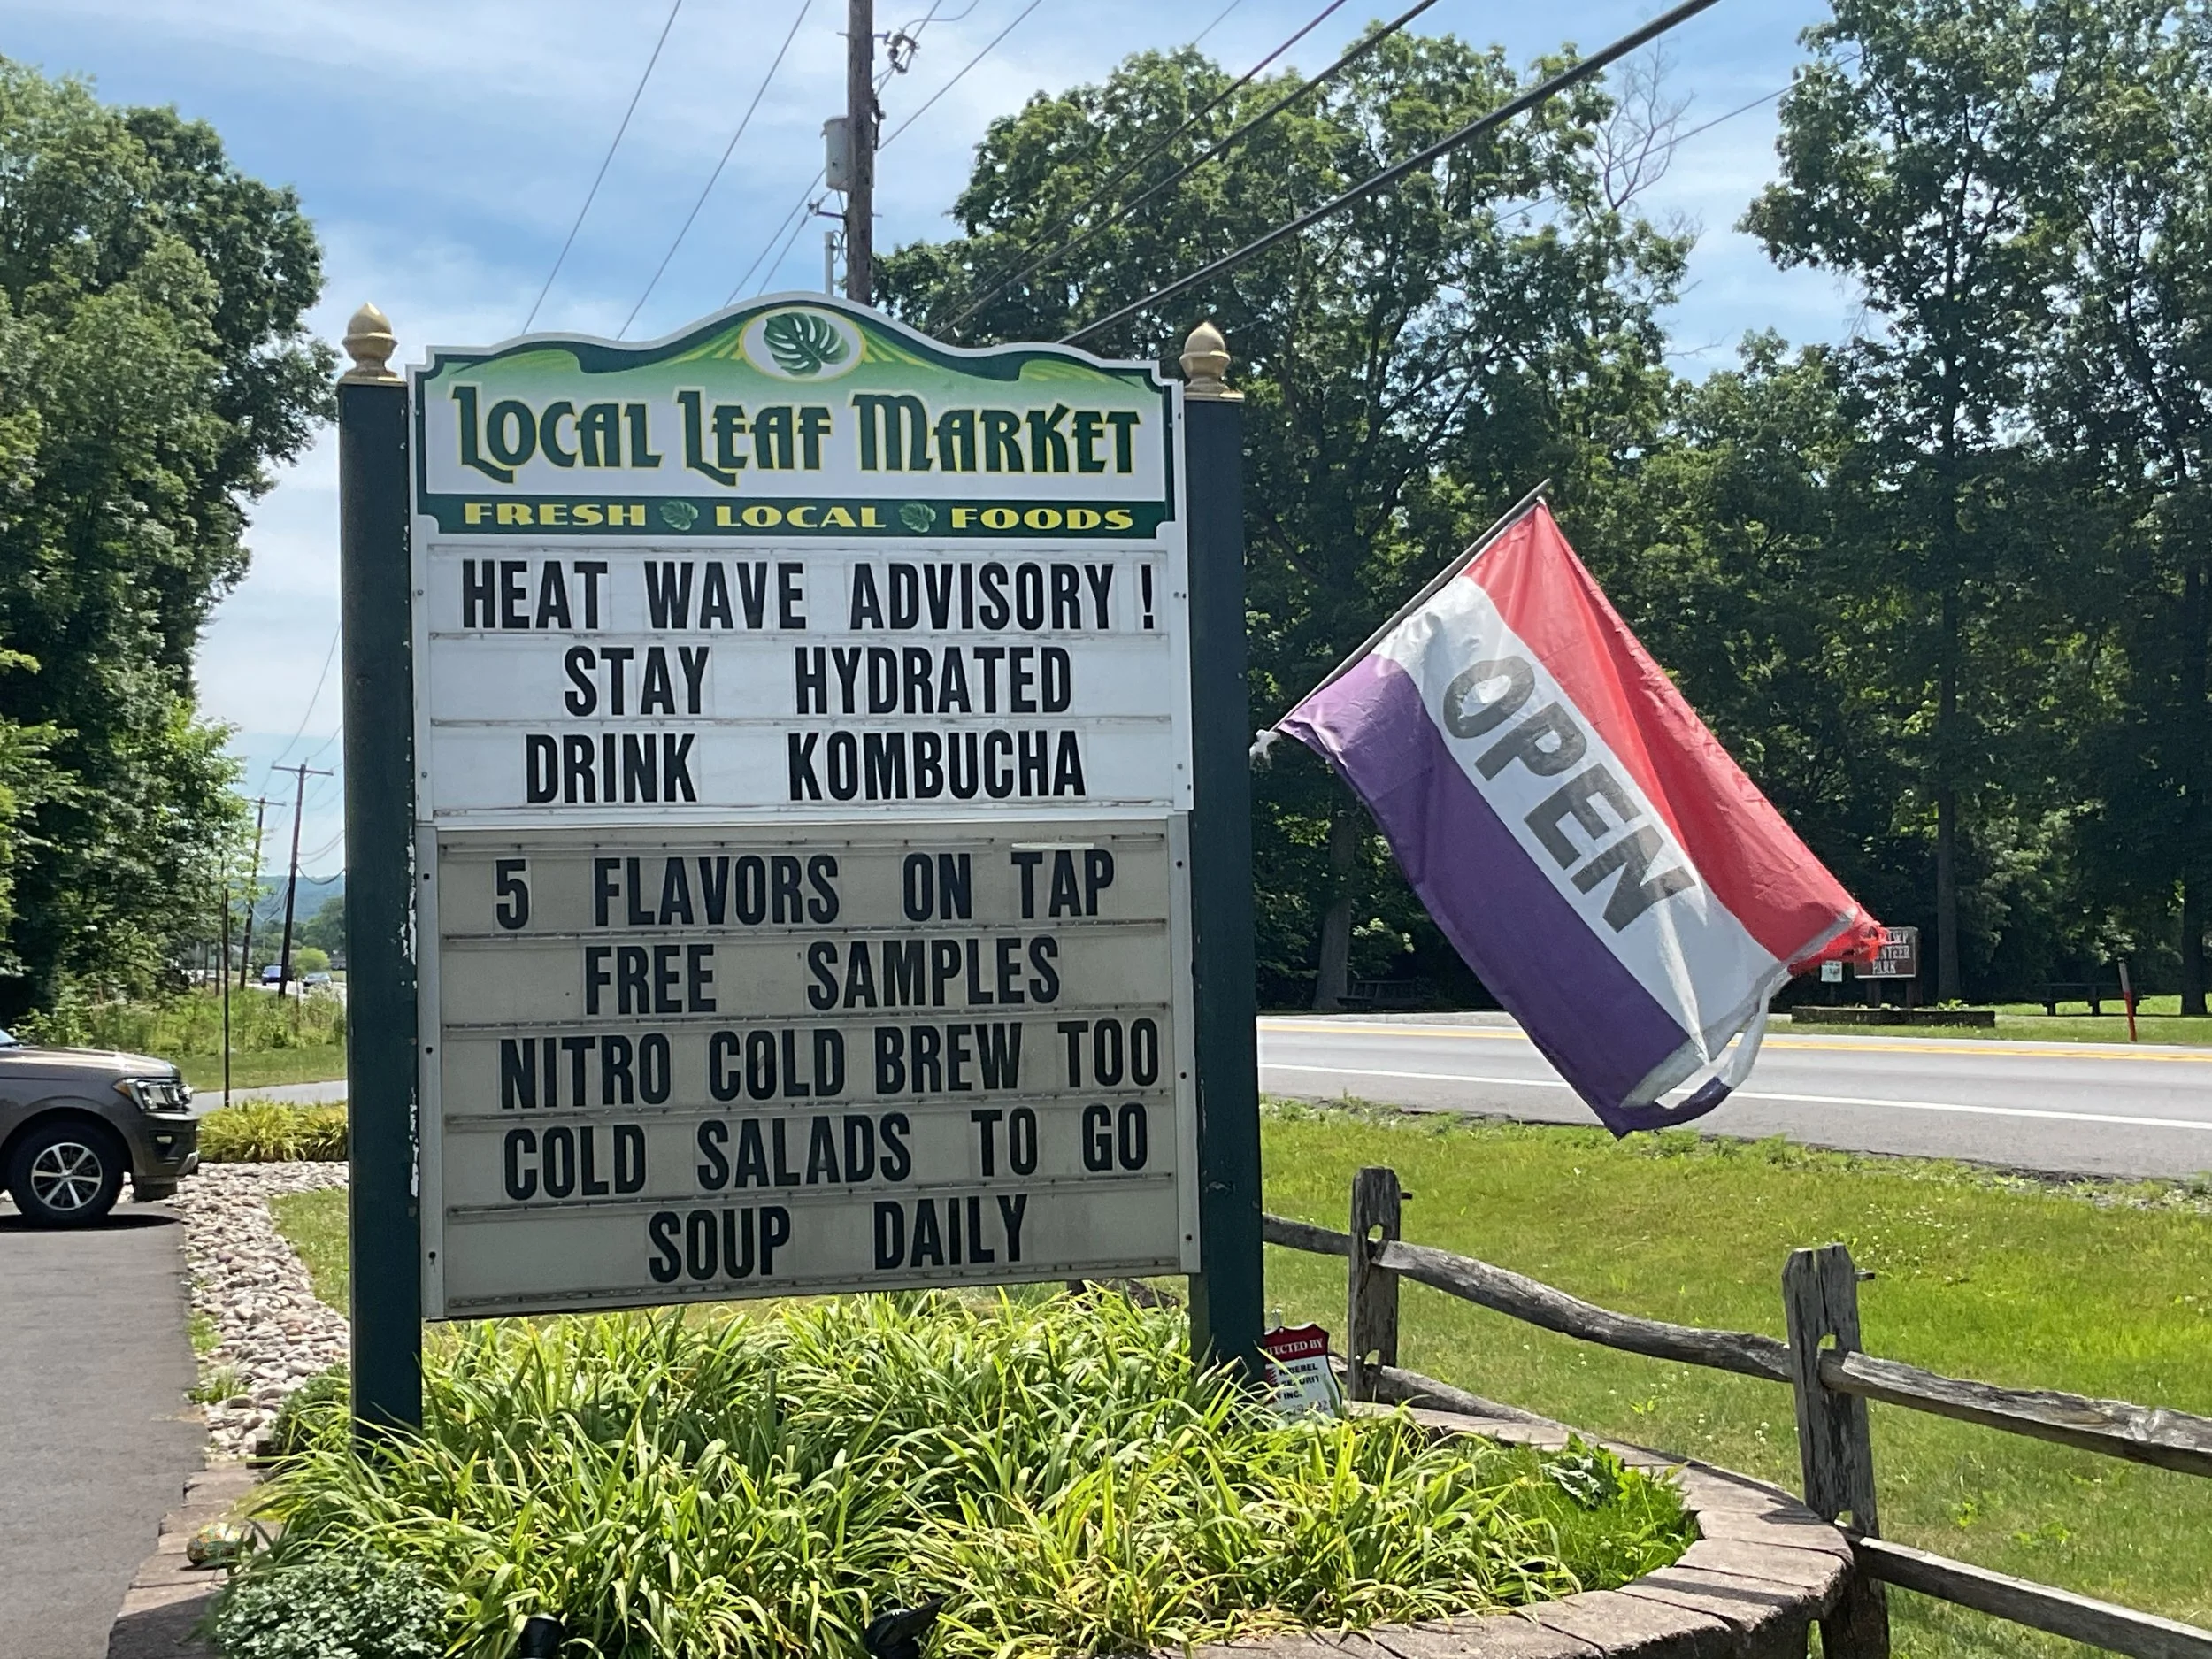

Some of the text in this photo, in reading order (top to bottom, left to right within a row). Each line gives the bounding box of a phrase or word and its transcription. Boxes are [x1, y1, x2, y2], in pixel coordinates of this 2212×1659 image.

[465, 503, 1133, 530] FRESH LOCAL FOODS
[463, 560, 608, 629] HEAT
[645, 561, 805, 630] WAVE
[565, 647, 1071, 717] STAY HYDRATED
[527, 730, 1086, 803] DRINK KOMBUCHA
[1443, 656, 1696, 933] OPEN
[496, 849, 1114, 929] 5 FLAVORS ON TAP
[587, 937, 1060, 1014] FREE SAMPLES
[501, 1018, 1158, 1110] NITRO COLD BREW TOO
[505, 1103, 1148, 1200] COLD SALADS TO GO
[649, 1194, 1026, 1282] SOUP DAILY
[1310, 1339, 1323, 1348] BY
